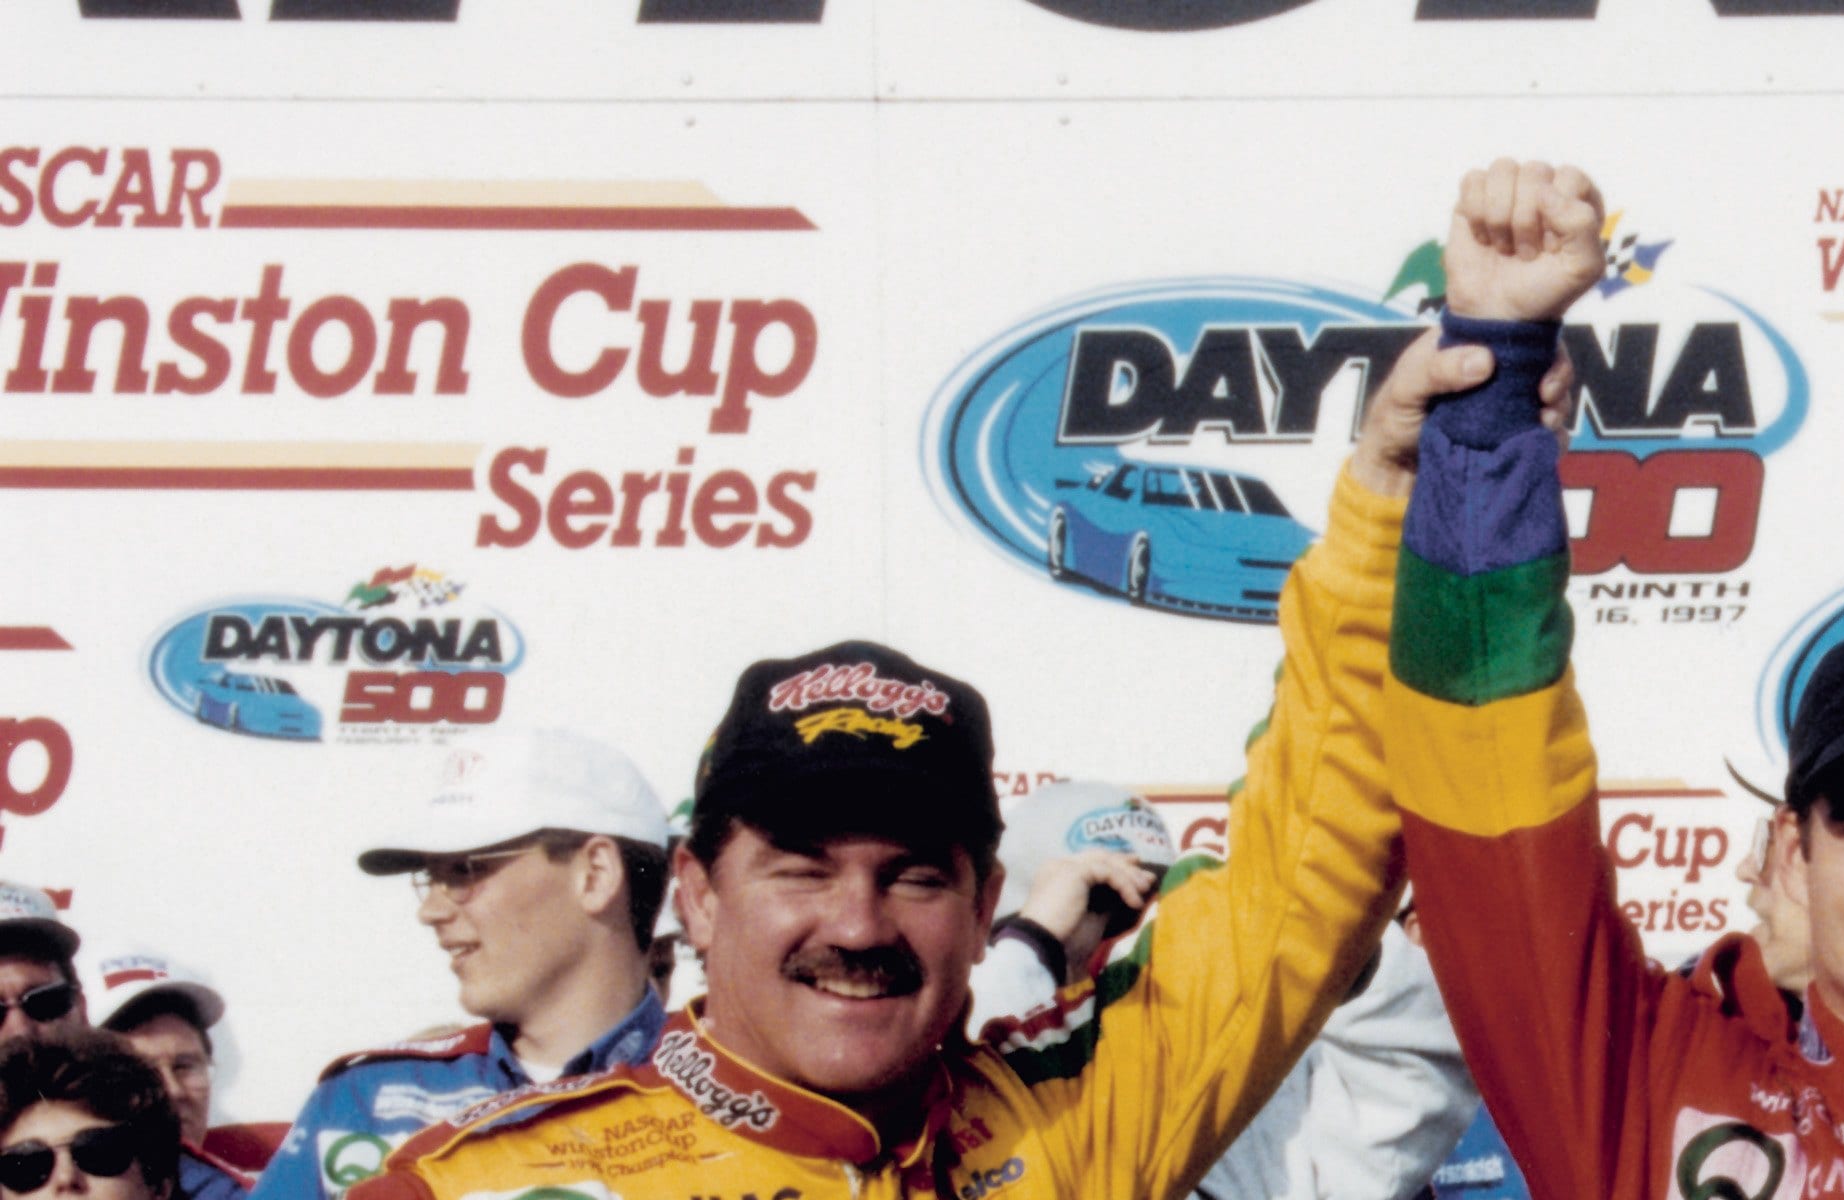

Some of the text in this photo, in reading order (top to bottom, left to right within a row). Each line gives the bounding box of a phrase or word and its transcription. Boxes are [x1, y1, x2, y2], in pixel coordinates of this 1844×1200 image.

[521, 262, 819, 435] Cup
[1057, 322, 1757, 443] DAYTNA
[475, 446, 818, 550] Series
[204, 615, 505, 664] DAYTONA
[1660, 604, 1748, 625] 1997
[338, 671, 507, 725] 500
[768, 661, 950, 718] Kellogg's
[1606, 812, 1729, 883] Cup
[1618, 888, 1729, 932] eries
[652, 1029, 780, 1134] Kellogg's
